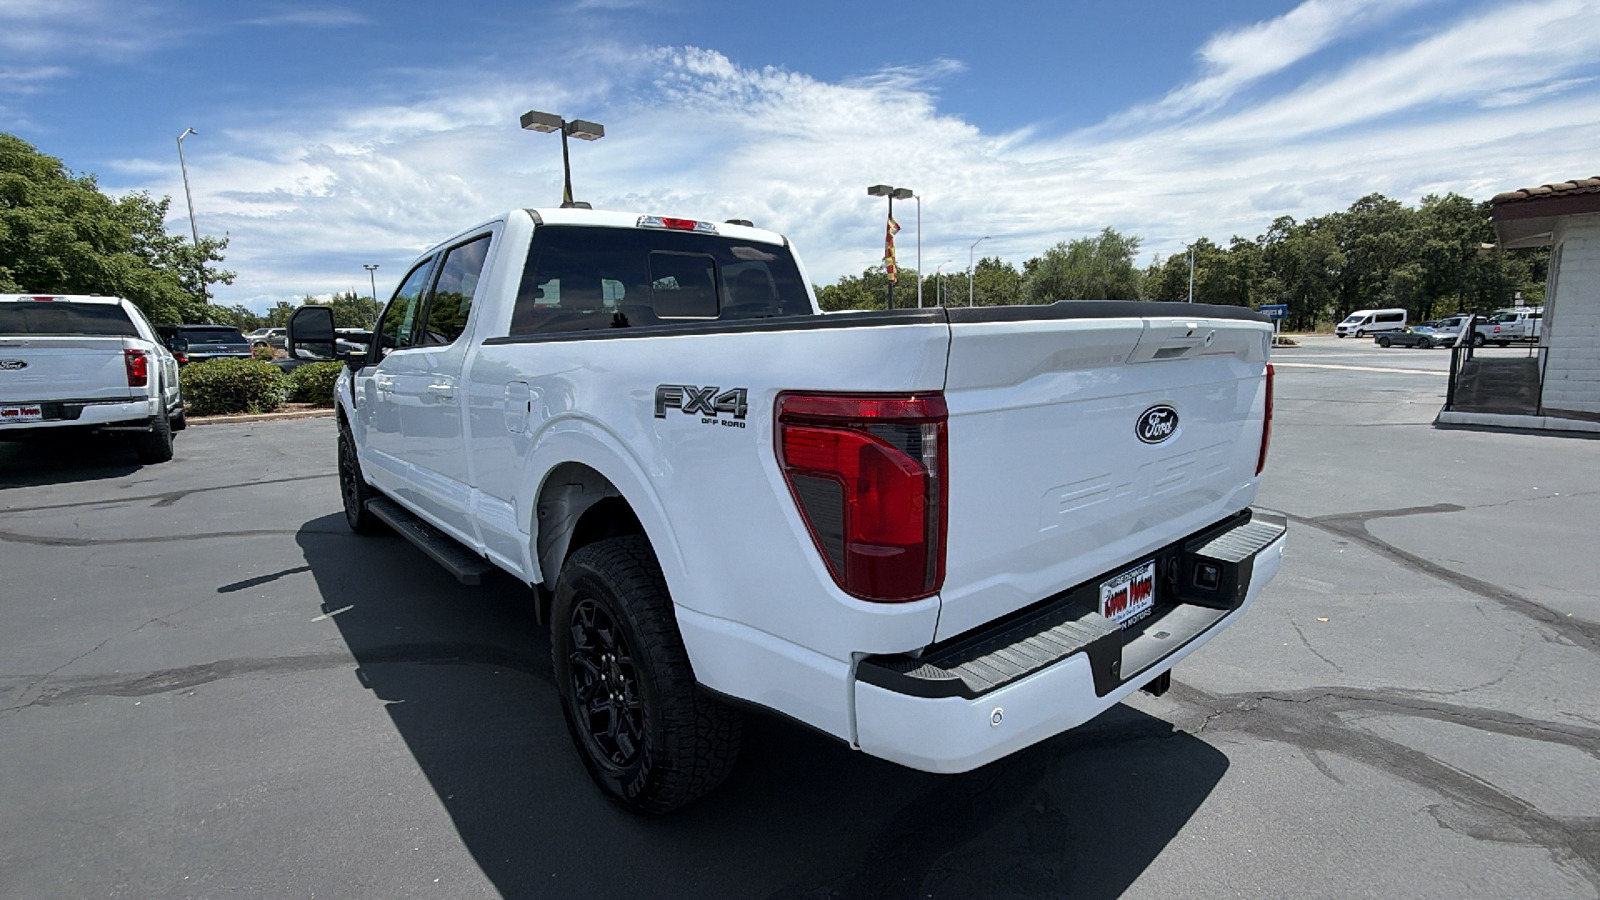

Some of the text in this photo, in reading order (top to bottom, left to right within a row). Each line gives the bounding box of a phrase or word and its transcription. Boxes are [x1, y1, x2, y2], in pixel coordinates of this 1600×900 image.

[654, 384, 748, 419] FX4
[721, 420, 746, 428] ROAD
[1145, 411, 1174, 437] Ford
[1128, 607, 1152, 627] MOTORS
